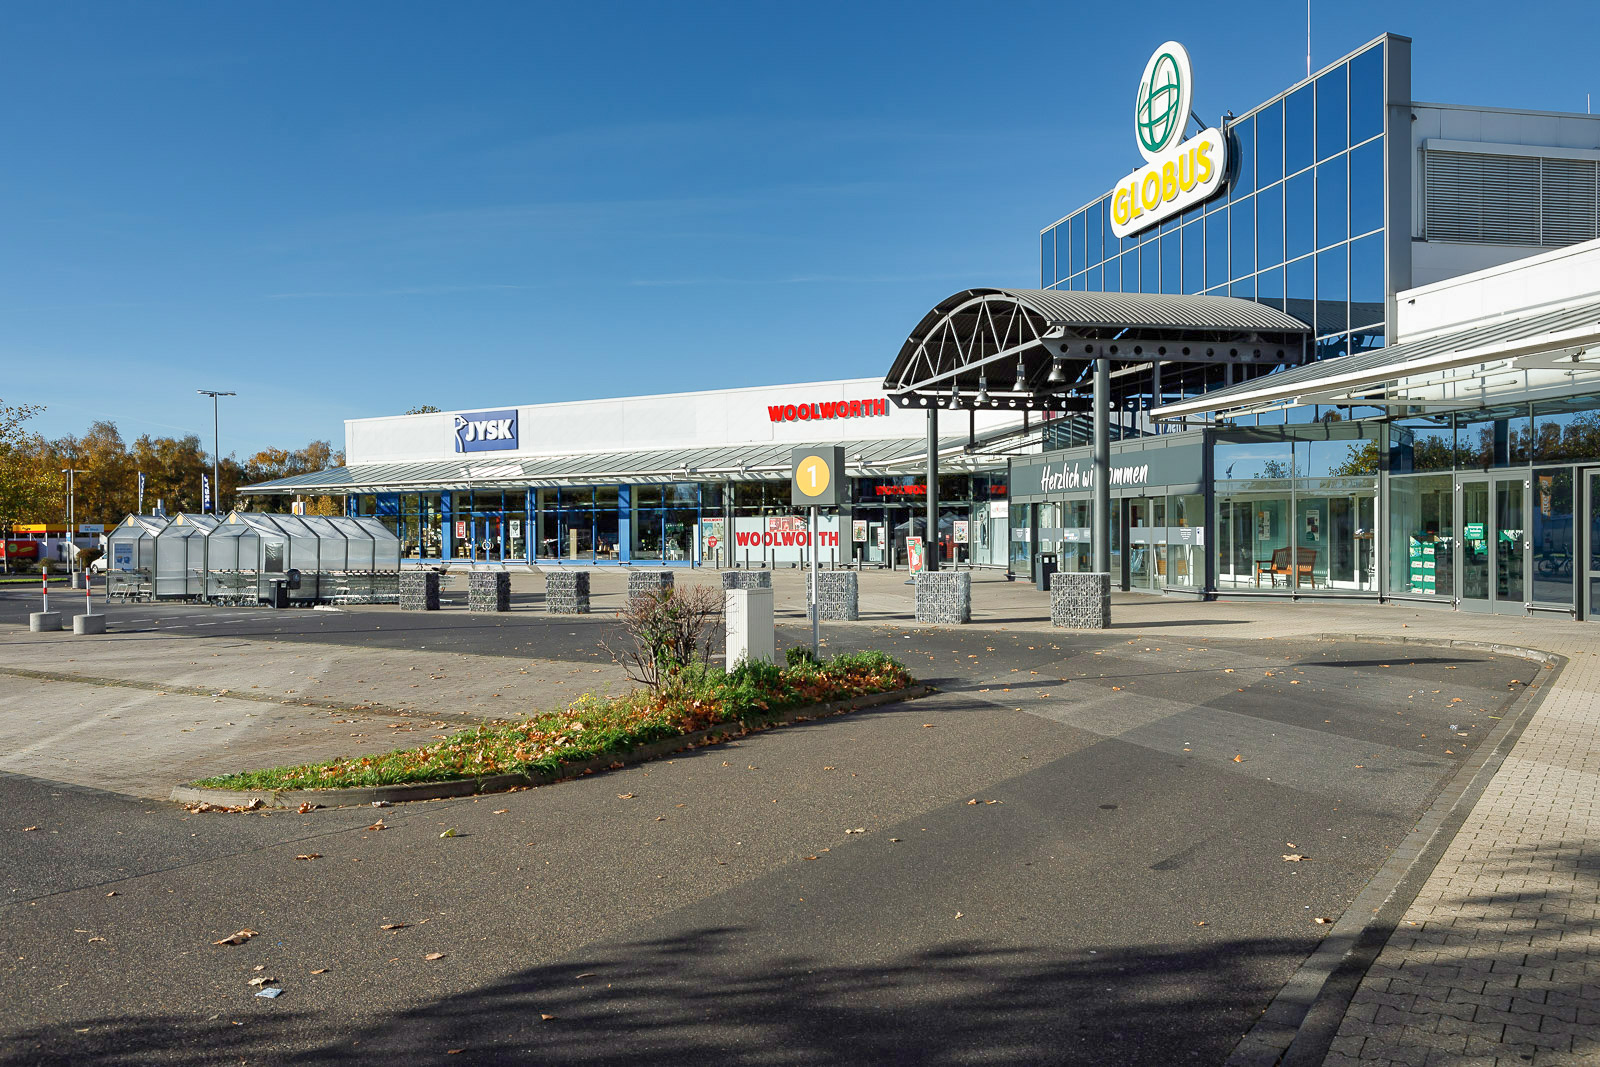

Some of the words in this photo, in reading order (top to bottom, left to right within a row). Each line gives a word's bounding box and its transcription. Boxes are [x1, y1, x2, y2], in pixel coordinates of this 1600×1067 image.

[1113, 141, 1213, 225] GLOBUS
[768, 398, 887, 422] WOOLWORTH
[465, 419, 513, 441] JYSK
[807, 465, 817, 487] 1
[1040, 462, 1080, 493] Herzlich
[875, 484, 927, 496] WOOLWOR
